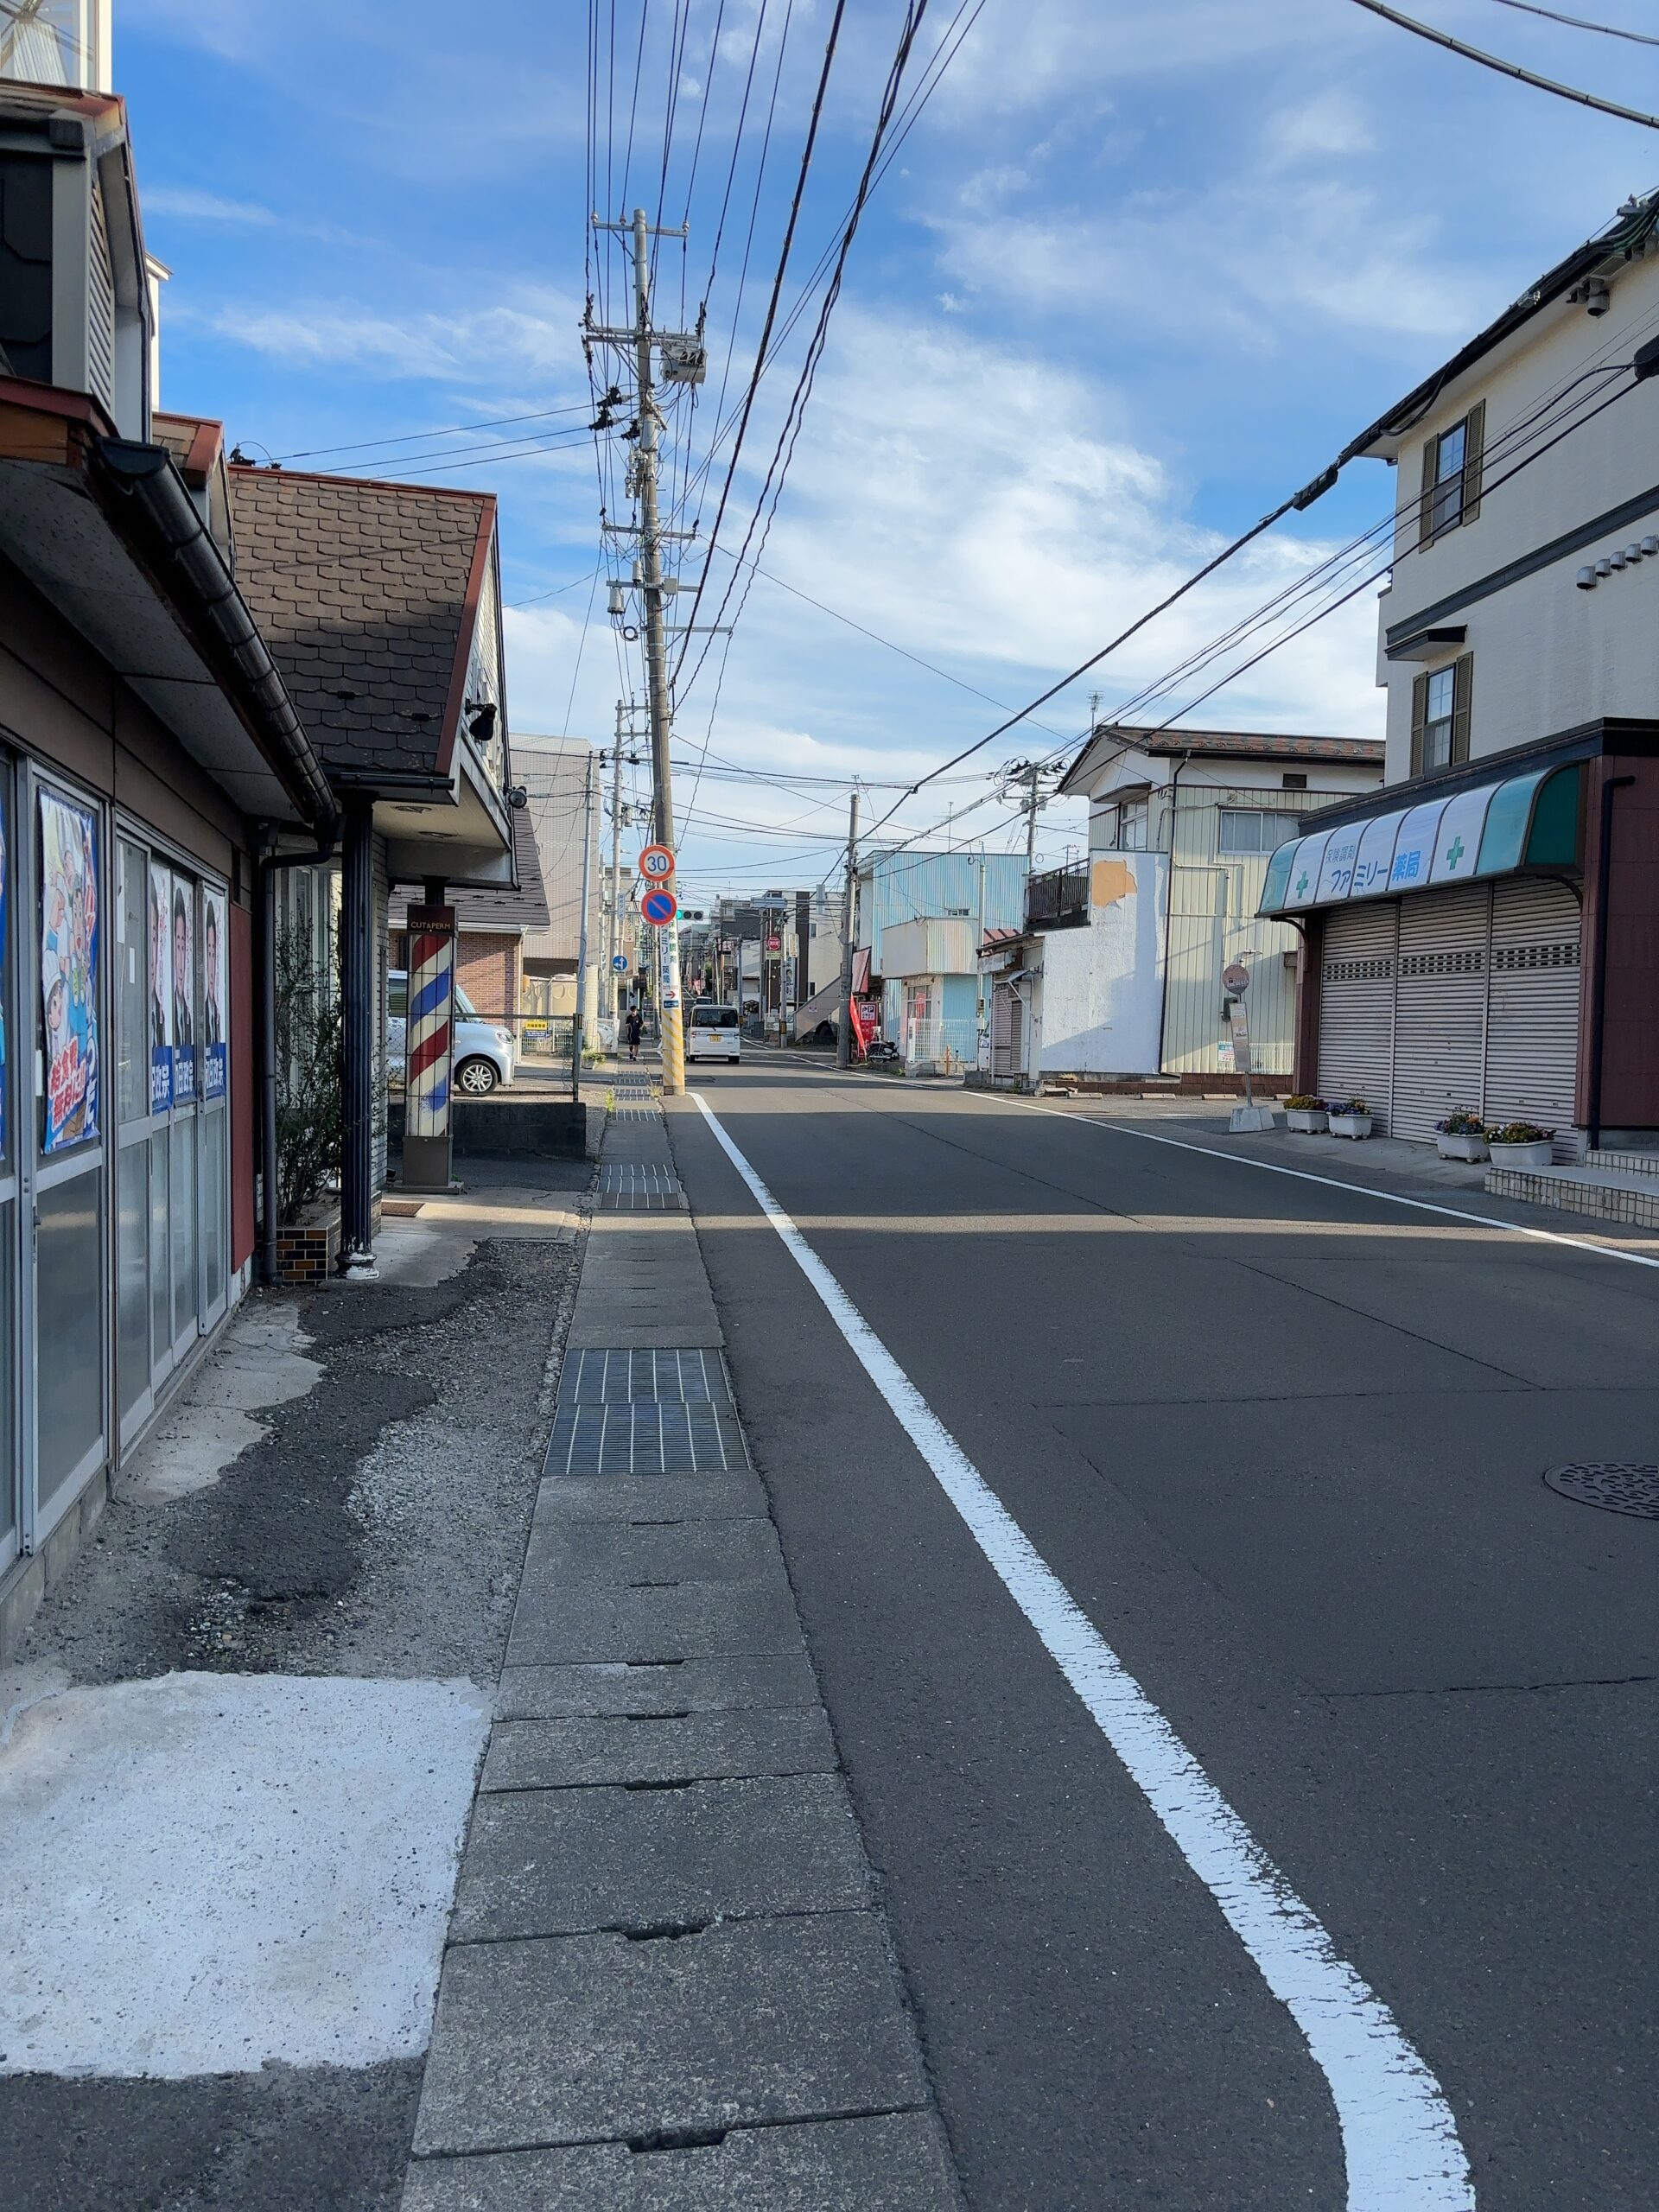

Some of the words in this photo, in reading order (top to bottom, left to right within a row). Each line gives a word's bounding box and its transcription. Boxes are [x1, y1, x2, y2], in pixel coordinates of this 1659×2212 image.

[647, 855, 667, 872] 30
[1325, 844, 1356, 864] 保険調剤
[1331, 850, 1421, 893] ファミリー薬局
[661, 925, 671, 983] ァミリー薬局
[51, 1039, 79, 1096] 給食費
